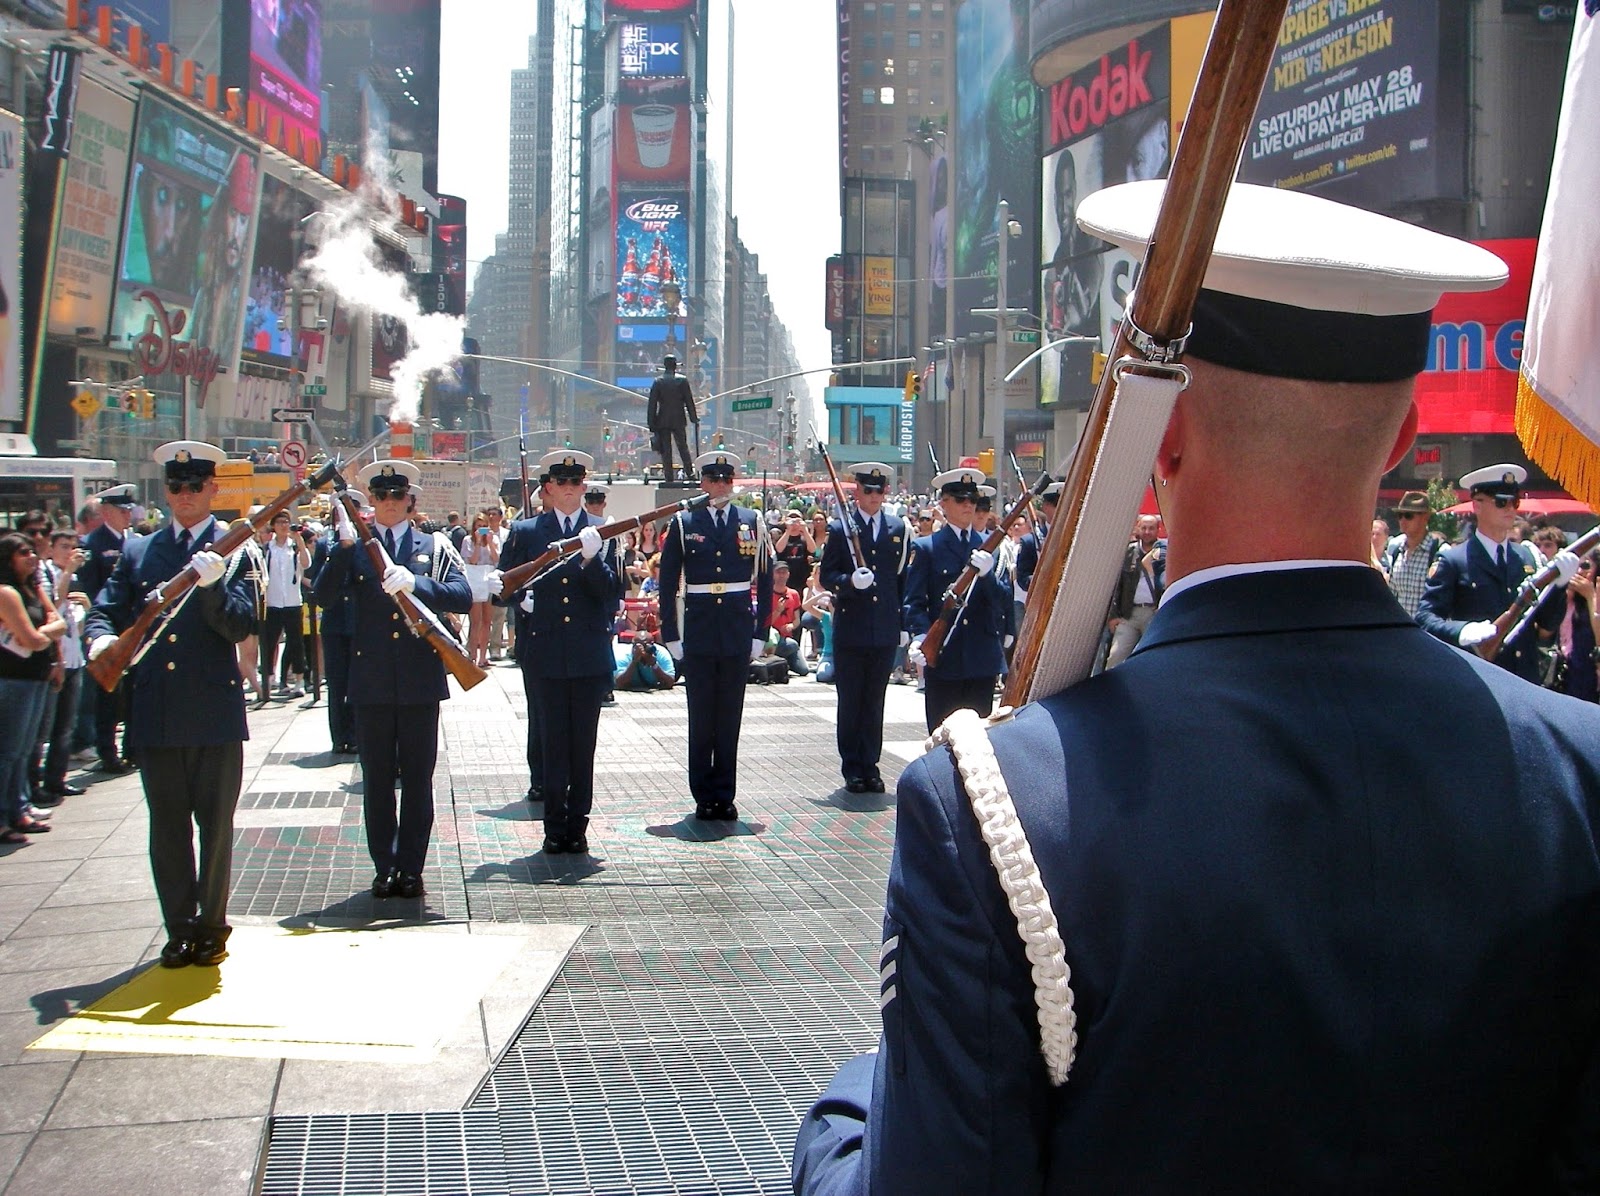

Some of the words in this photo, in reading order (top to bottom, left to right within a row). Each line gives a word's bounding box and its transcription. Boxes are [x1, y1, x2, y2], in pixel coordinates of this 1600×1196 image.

[1280, 1, 1329, 47] PAGE
[1281, 28, 1344, 63] HEAVYWEIGHT
[1347, 10, 1384, 34] BATTLE
[1274, 56, 1306, 92] MIR
[1306, 52, 1321, 76] VS
[1321, 17, 1394, 72] NELSON
[1050, 38, 1152, 147] Kodak
[1259, 91, 1340, 138] SATURDAY
[1344, 75, 1381, 107] MAY
[1387, 65, 1412, 92] 28
[1252, 132, 1282, 159] LIVE
[1283, 124, 1306, 148] ON
[1308, 82, 1422, 140] PAY-PER-VIEW
[633, 211, 681, 219] LIGHT
[641, 203, 679, 212] BUD
[643, 221, 670, 232] UFC
[871, 267, 887, 276] THE
[737, 401, 767, 410] Broadway
[898, 389, 913, 460] AÉROPOSTA
[418, 479, 461, 488] Beverages
